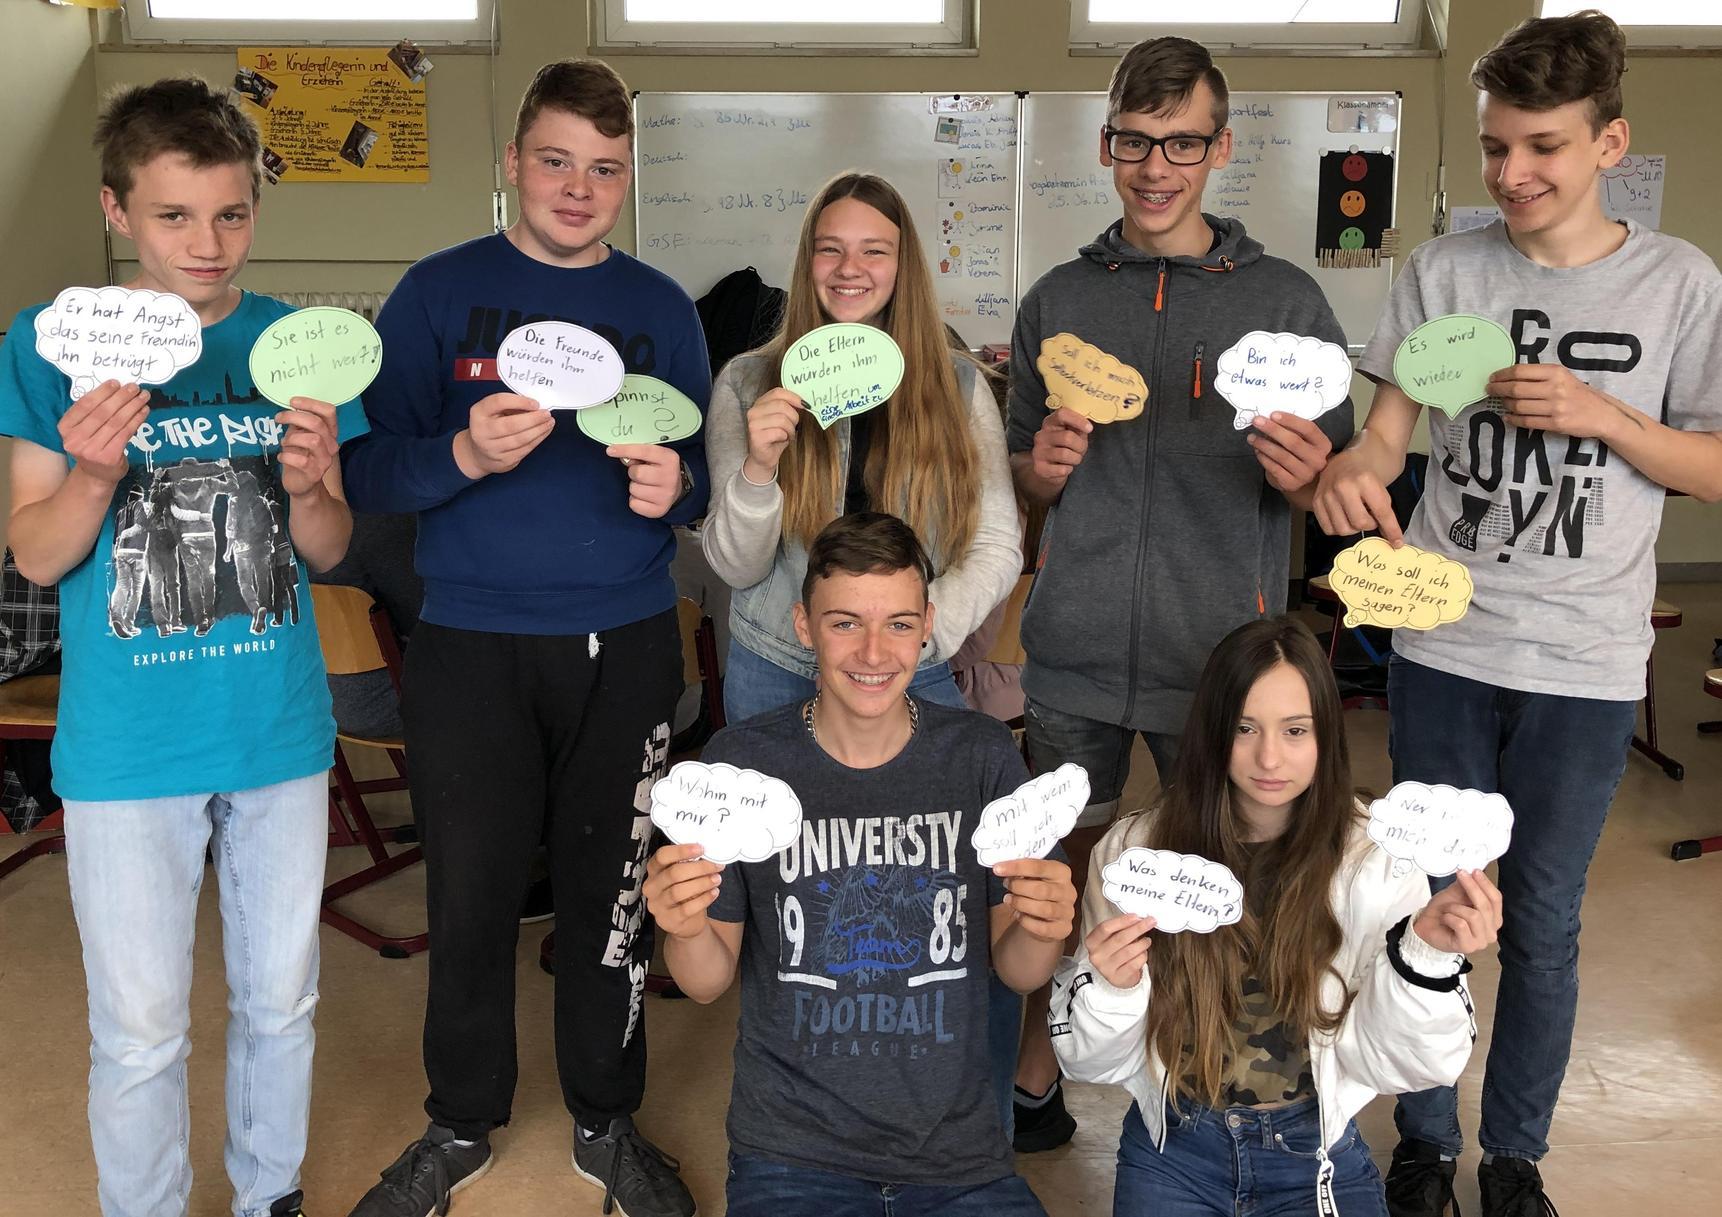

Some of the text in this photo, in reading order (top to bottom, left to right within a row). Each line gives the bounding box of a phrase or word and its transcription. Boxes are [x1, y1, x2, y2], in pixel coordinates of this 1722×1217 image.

[254, 52, 278, 71] Die
[370, 61, 388, 72] und
[1229, 104, 1274, 120] portfest
[66, 298, 185, 332] Er hat Angst
[50, 318, 198, 348] das seine Freundin
[272, 320, 350, 350] Sie ist es
[525, 328, 604, 362] Die Freunde
[1408, 326, 1476, 354] Es wird
[56, 344, 159, 377] ihn betrügt
[506, 347, 585, 374] würden ihm
[799, 335, 865, 361] Die Eltern
[1247, 348, 1296, 366] Bin ich
[270, 352, 322, 383] nicht
[508, 366, 554, 387] helfen
[790, 351, 878, 384] würden ihm
[1230, 368, 1266, 387] etwas
[1280, 378, 1310, 392] wert
[812, 384, 860, 407] helfen
[610, 414, 634, 438] du
[1451, 528, 1474, 548] EDGE
[1357, 550, 1449, 590] Was soll ich
[1342, 571, 1448, 606] meinen Eltern
[1362, 597, 1402, 614] sagen
[133, 638, 276, 666] EXPLORE THE WORLD
[680, 776, 768, 808] Wohin mit
[676, 807, 708, 825] mir
[993, 829, 1016, 848] soll
[1120, 882, 1166, 900] meine
[1129, 859, 1229, 897] Was denken
[929, 884, 968, 965] 85
[792, 990, 954, 1043] FOOTBALL
